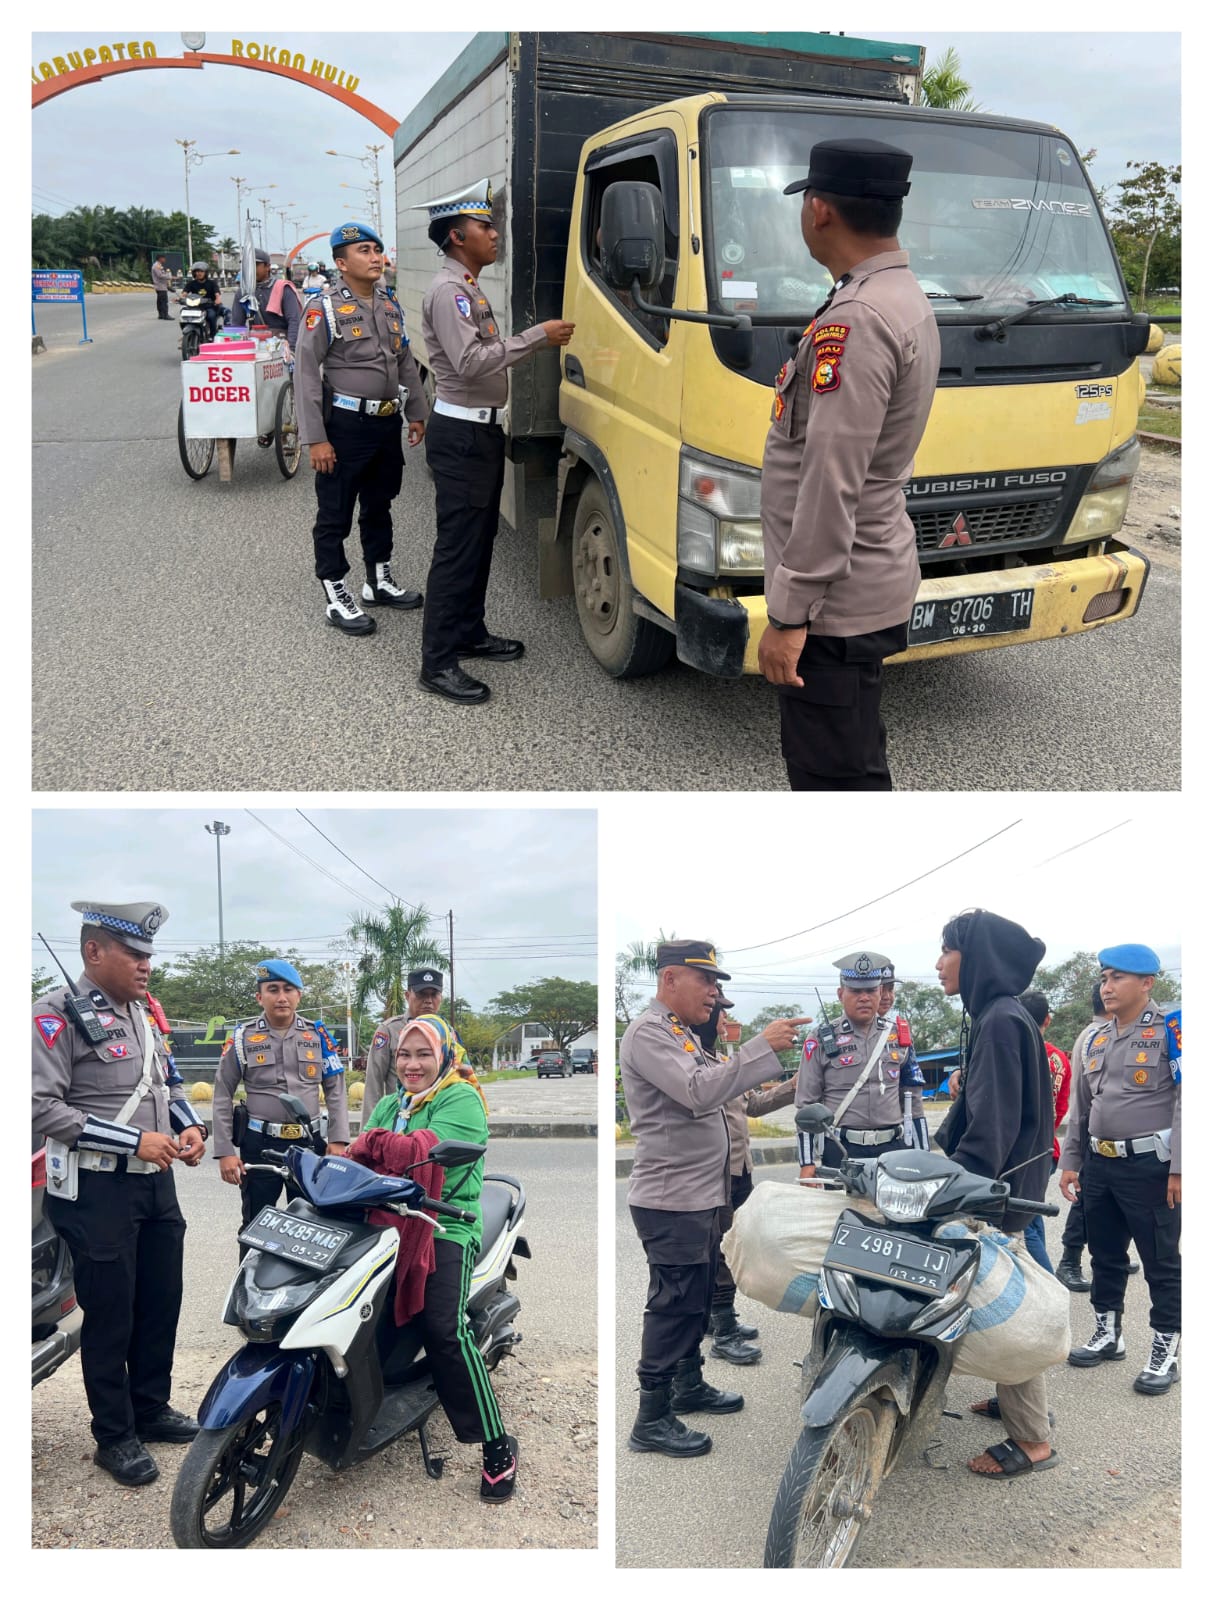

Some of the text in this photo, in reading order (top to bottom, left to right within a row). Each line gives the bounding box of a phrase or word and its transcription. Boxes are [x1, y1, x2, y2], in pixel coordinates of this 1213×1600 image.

[32, 39, 360, 92] KABUPATEN ROKAN HULU
[208, 367, 233, 382] ES
[189, 386, 251, 403] DOGER
[900, 471, 1067, 496] SUBISHI FUSO
[911, 591, 1032, 630] BM 9706 TH
[106, 1027, 127, 1040] PRI
[298, 1041, 320, 1049] POLRI
[1130, 1041, 1160, 1049] POLRI
[259, 1213, 341, 1249] BM 5485 MAG
[837, 1229, 850, 1246] Z
[860, 1235, 903, 1260] 4981
